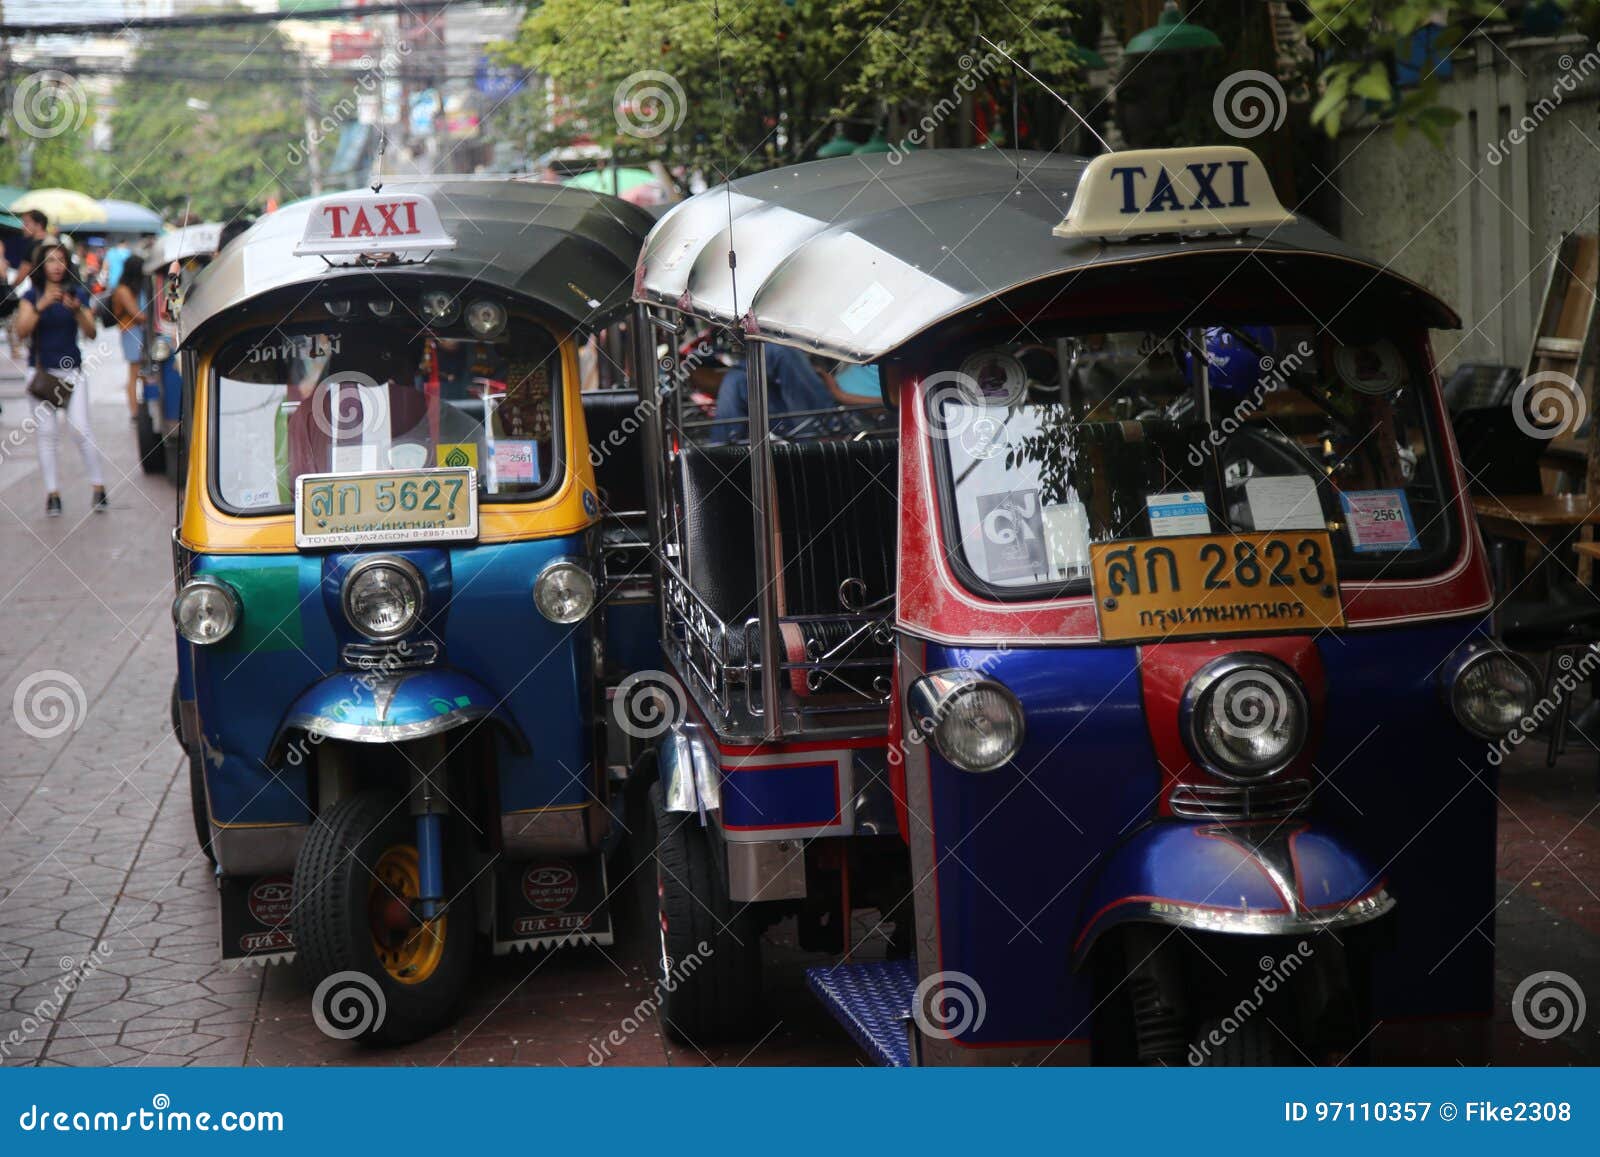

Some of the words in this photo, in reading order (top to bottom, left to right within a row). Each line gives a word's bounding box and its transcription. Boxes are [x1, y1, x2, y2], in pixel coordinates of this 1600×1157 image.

[1111, 161, 1251, 214] TAXI
[323, 201, 421, 238] TAXI
[510, 453, 532, 463] 2561
[311, 483, 361, 517] สก
[375, 478, 464, 513] 5627
[1373, 509, 1404, 521] 2561
[308, 535, 350, 545] TOYOTA
[355, 532, 409, 542] PARAGON
[1104, 545, 1181, 596] สก
[1200, 538, 1325, 590] 2823
[1139, 601, 1306, 630] กรุงเทพมหานคร
